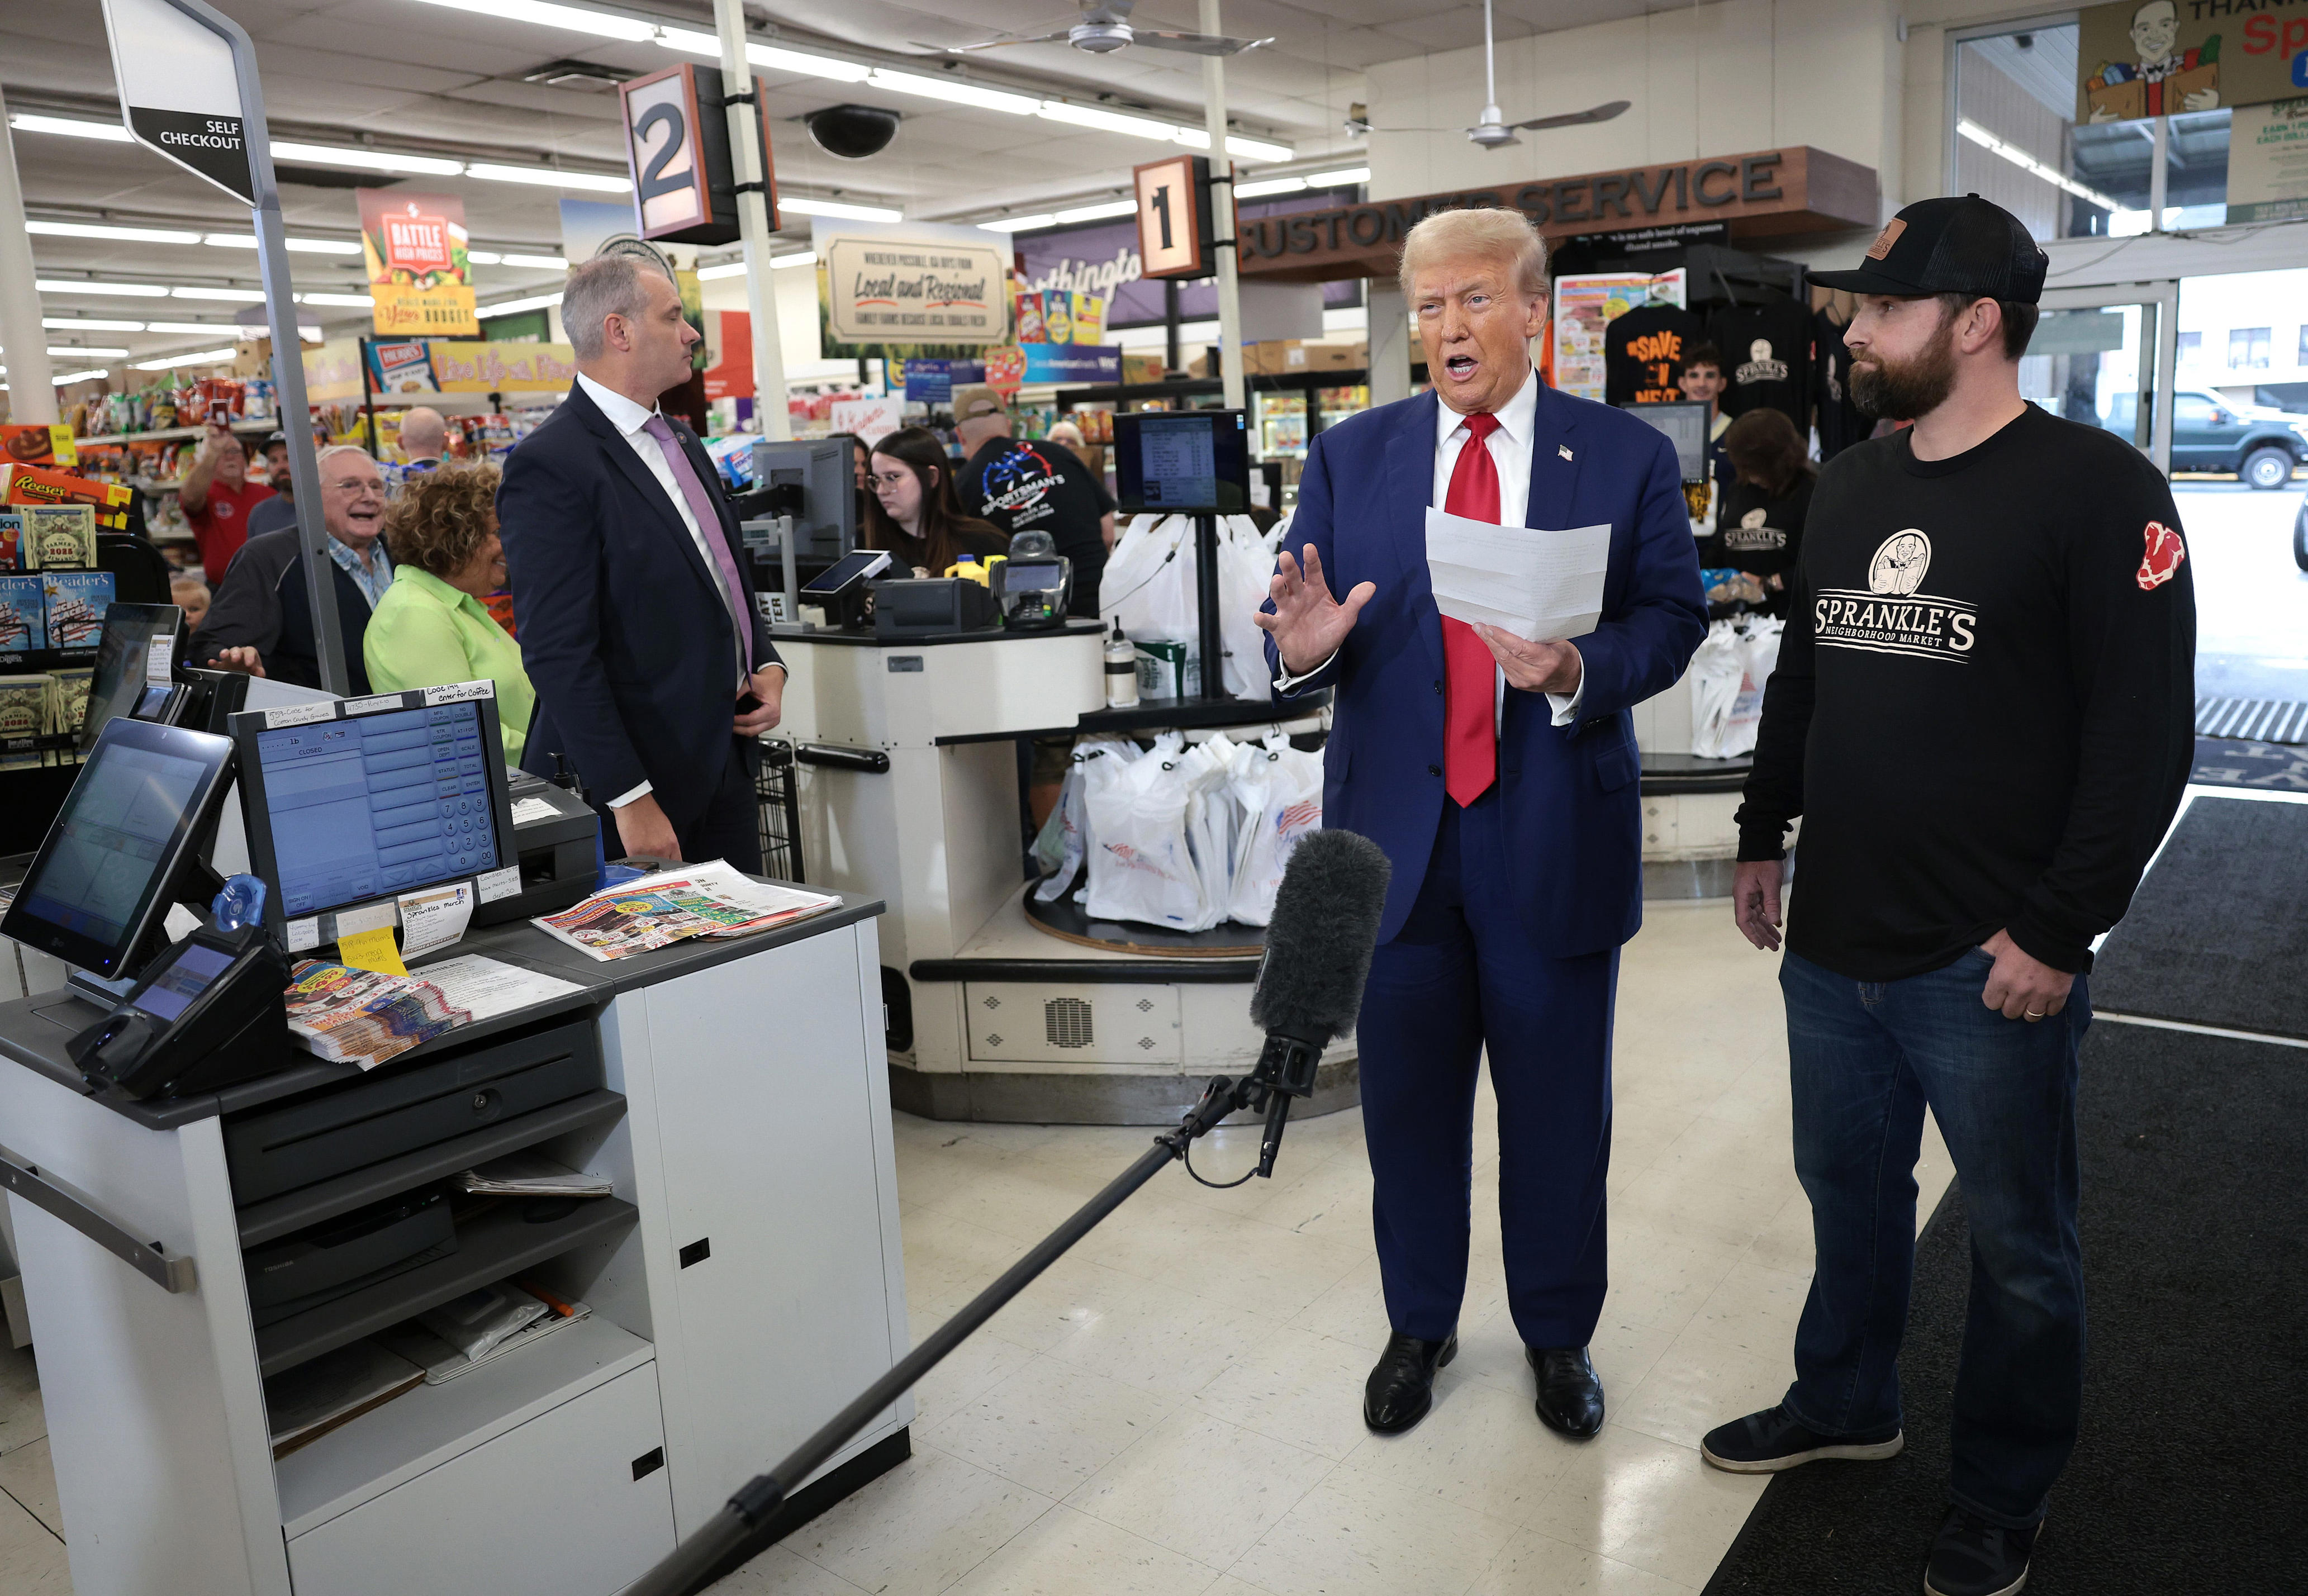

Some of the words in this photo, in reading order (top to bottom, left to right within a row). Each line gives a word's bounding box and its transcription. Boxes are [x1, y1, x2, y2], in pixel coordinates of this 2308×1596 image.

[2188, 0, 2308, 20] THA
[206, 121, 239, 135] SELF
[160, 131, 241, 150] CHECKOUT
[634, 103, 695, 204] 2
[1515, 152, 1783, 224] SERVICE
[1152, 185, 1174, 250] 1
[391, 222, 443, 248] BATTLE
[855, 272, 896, 298] Local
[897, 273, 925, 298] and
[925, 272, 986, 306] Regional
[981, 474, 1065, 515] SPORTSMAN'S
[1815, 599, 1976, 651] SPRANKLE'S
[1825, 626, 1896, 641] NEIGHBORHOOD
[1899, 633, 1943, 647] MARKET
[457, 690, 467, 698] for
[468, 687, 490, 697] Coffee
[299, 747, 322, 755] CLOSED
[482, 851, 491, 859] 00
[576, 901, 596, 913] Daily
[412, 962, 463, 977] CASHIERS
[264, 1260, 296, 1274] TOSHIBA
